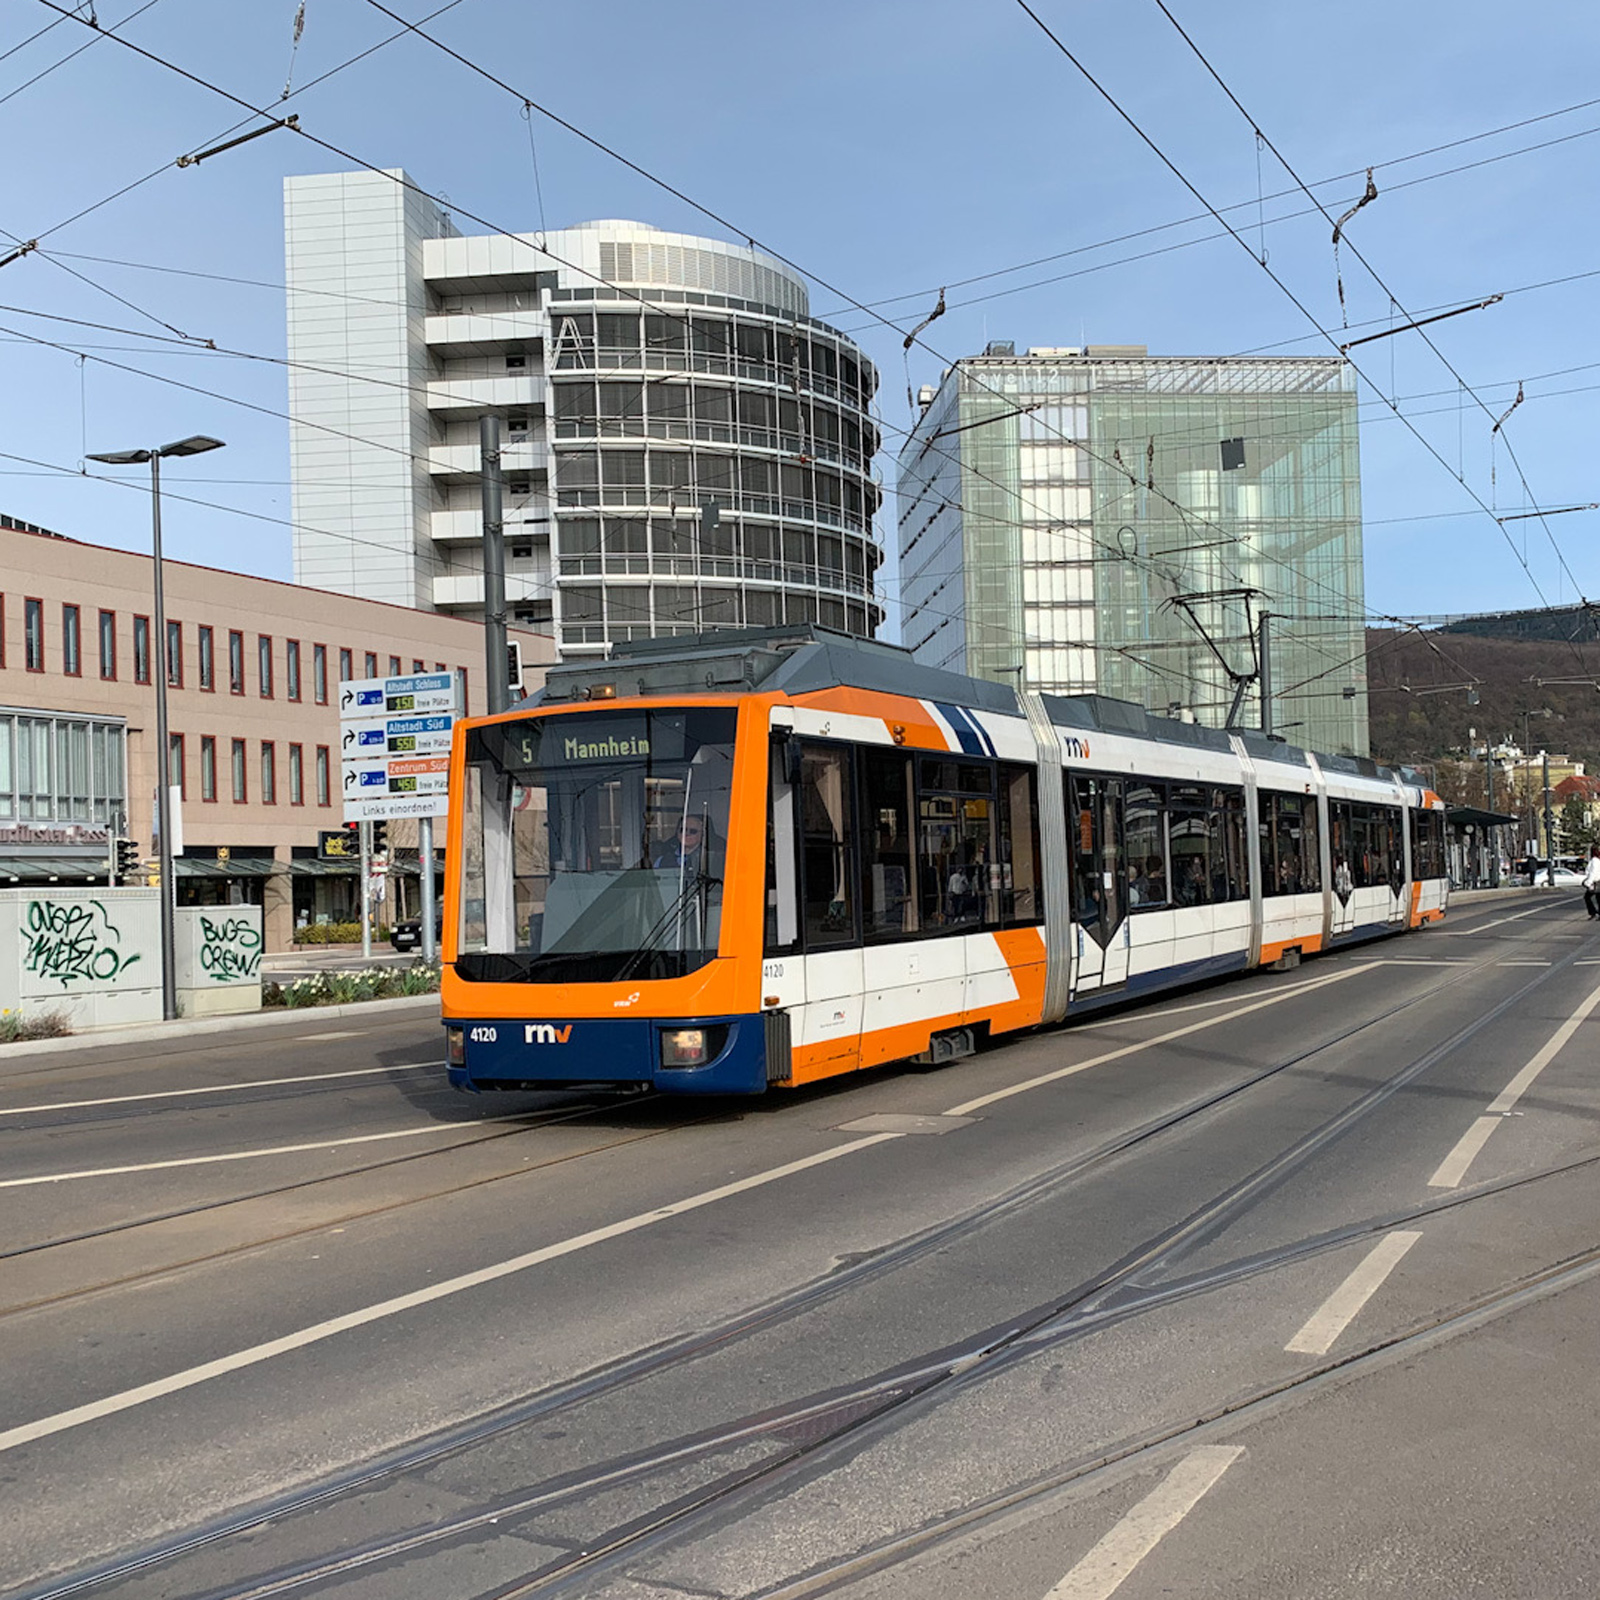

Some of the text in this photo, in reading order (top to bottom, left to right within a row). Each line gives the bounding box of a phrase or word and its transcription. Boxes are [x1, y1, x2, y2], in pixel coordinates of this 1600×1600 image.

[387, 679, 441, 692] Altstadt Schloss
[358, 693, 366, 704] P
[396, 697, 414, 710] 150
[388, 718, 444, 733] Altstadt Süd
[360, 733, 367, 745] P
[396, 738, 415, 750] 550
[522, 735, 650, 763] 5 Mannheim
[389, 760, 448, 774] Zentrum Süd
[361, 774, 369, 785] P
[397, 778, 416, 791] 450
[363, 801, 437, 816] Links einordnen!
[200, 916, 260, 948] BUGS
[764, 963, 784, 978] 4120
[470, 1027, 497, 1042] 4120
[524, 1024, 573, 1044] rnv
